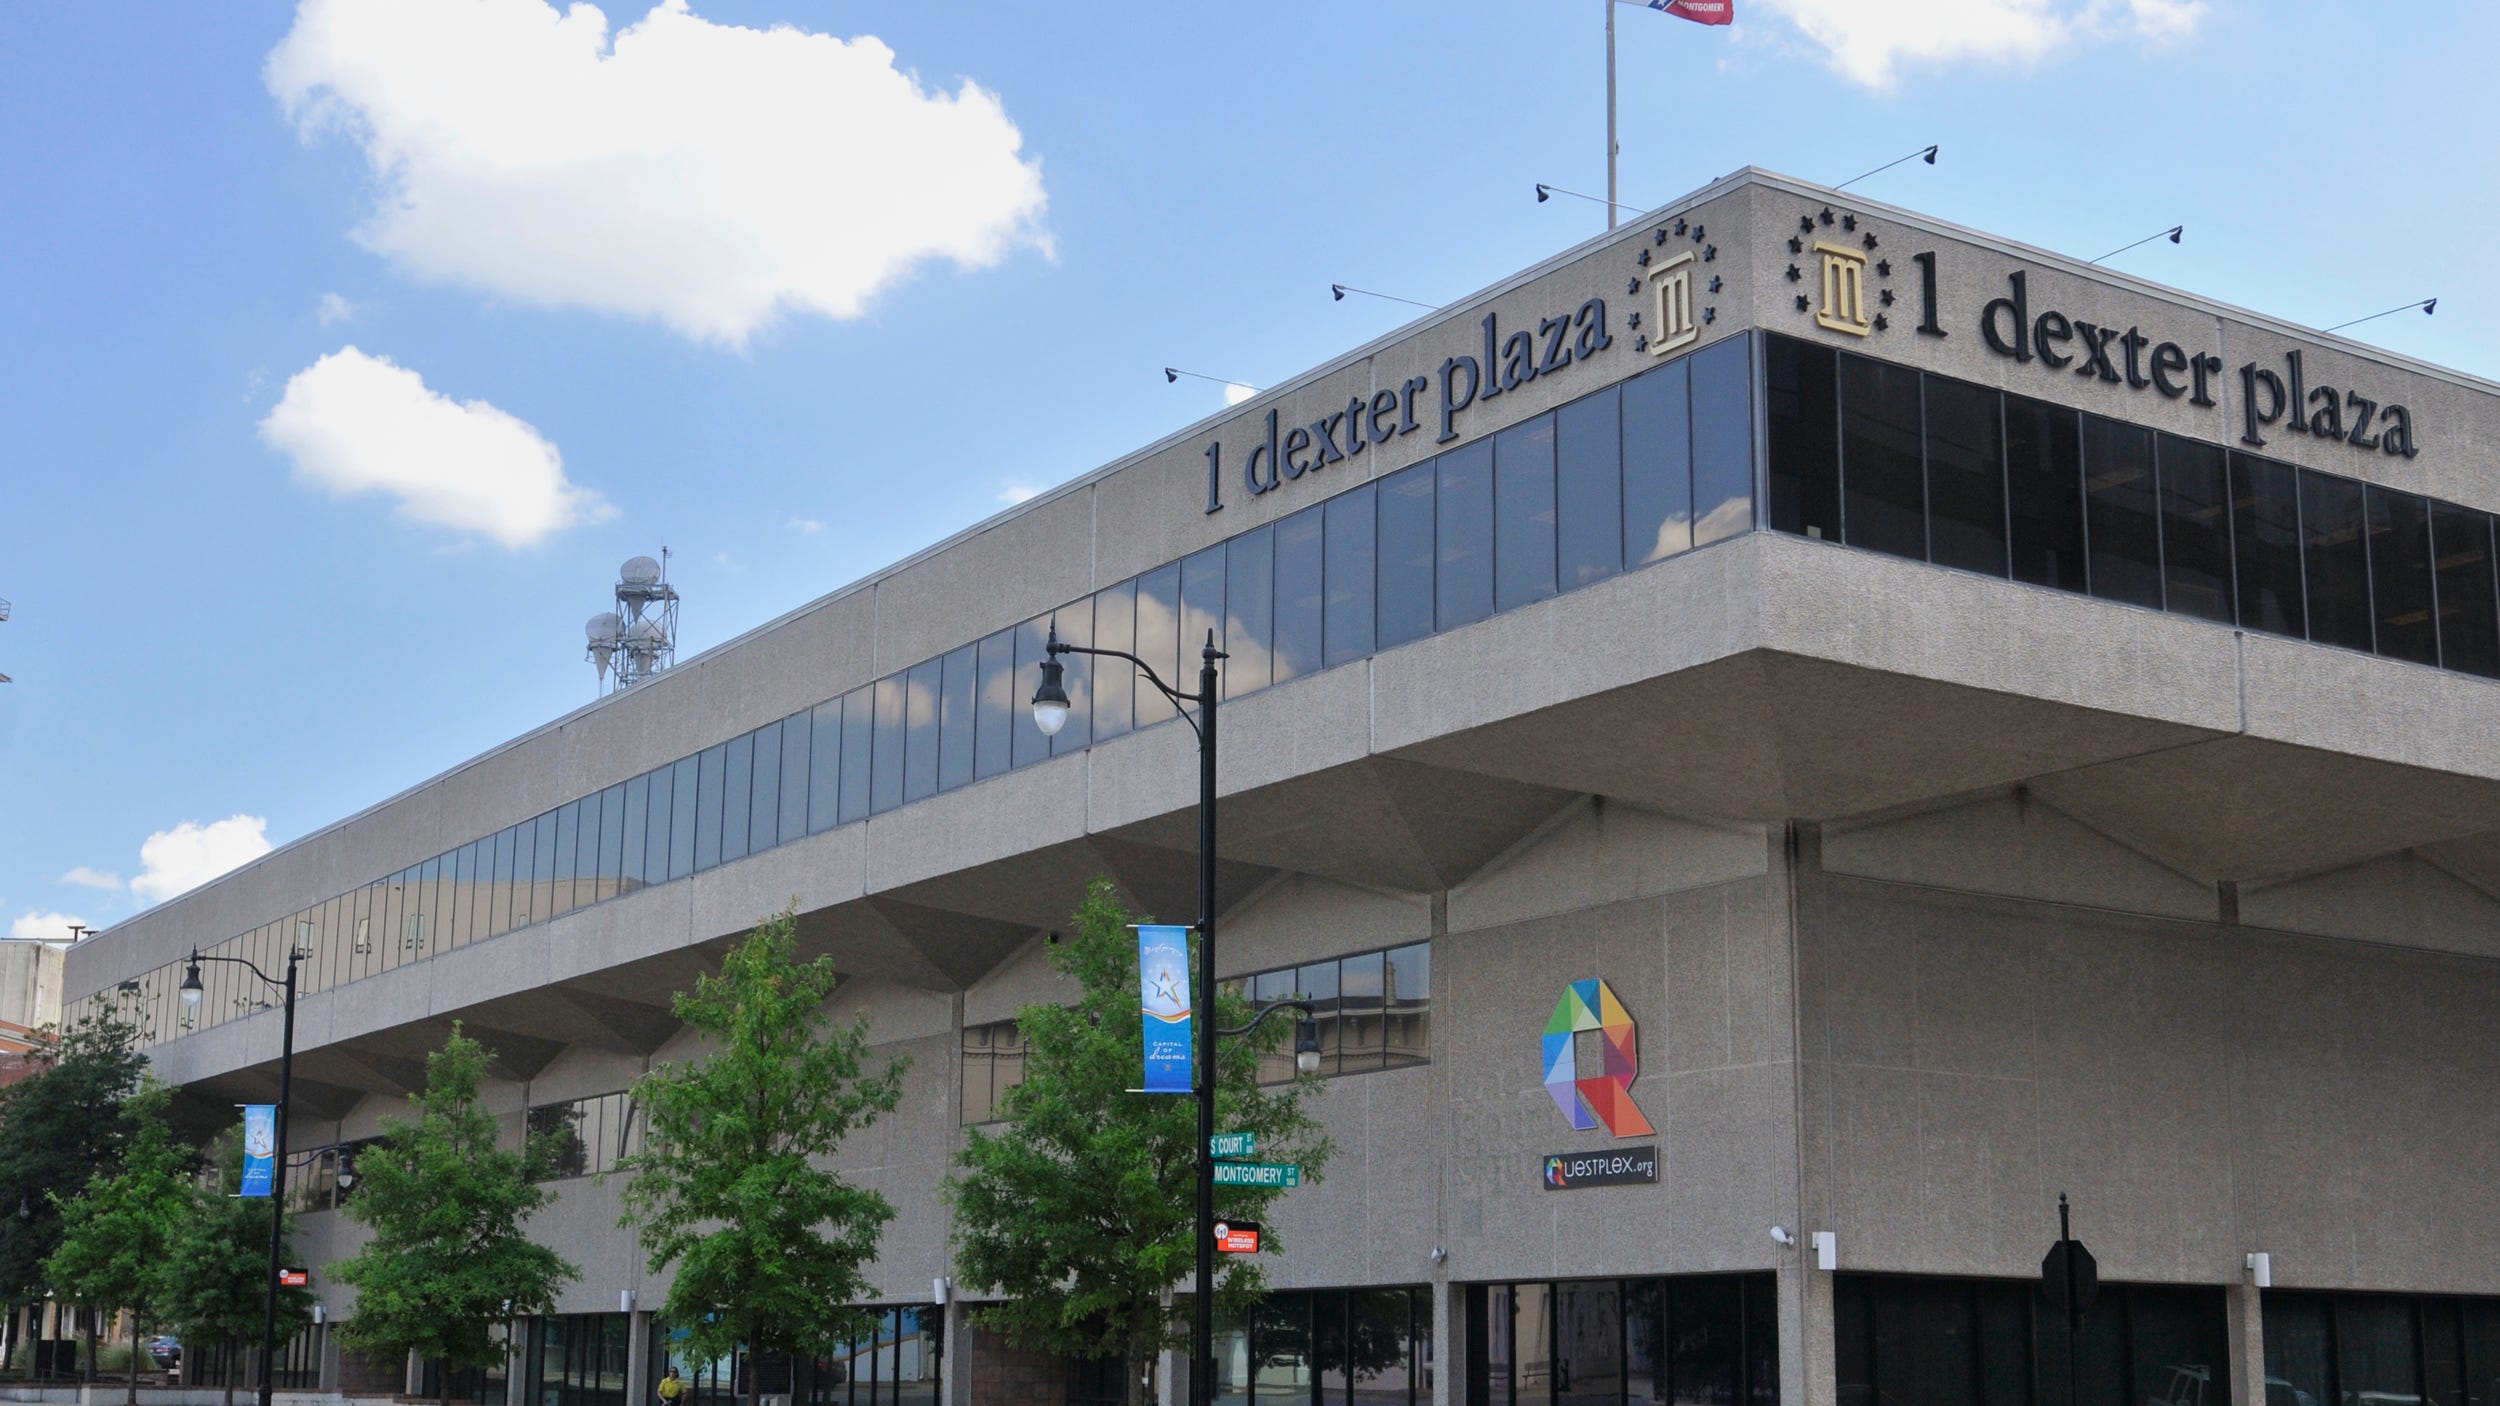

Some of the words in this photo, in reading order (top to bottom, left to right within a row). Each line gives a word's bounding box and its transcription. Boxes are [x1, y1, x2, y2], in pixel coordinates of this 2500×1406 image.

[1244, 374, 1427, 496] dexter
[1435, 297, 1613, 444] plaza
[1980, 269, 2223, 408] dexter
[2240, 349, 2420, 458] plaza
[1210, 1139, 1216, 1155] S
[1218, 1137, 1243, 1153] COURT
[1246, 1134, 1252, 1142] ST
[1215, 1166, 1282, 1183] MONTGOMERY
[1287, 1168, 1295, 1176] ST
